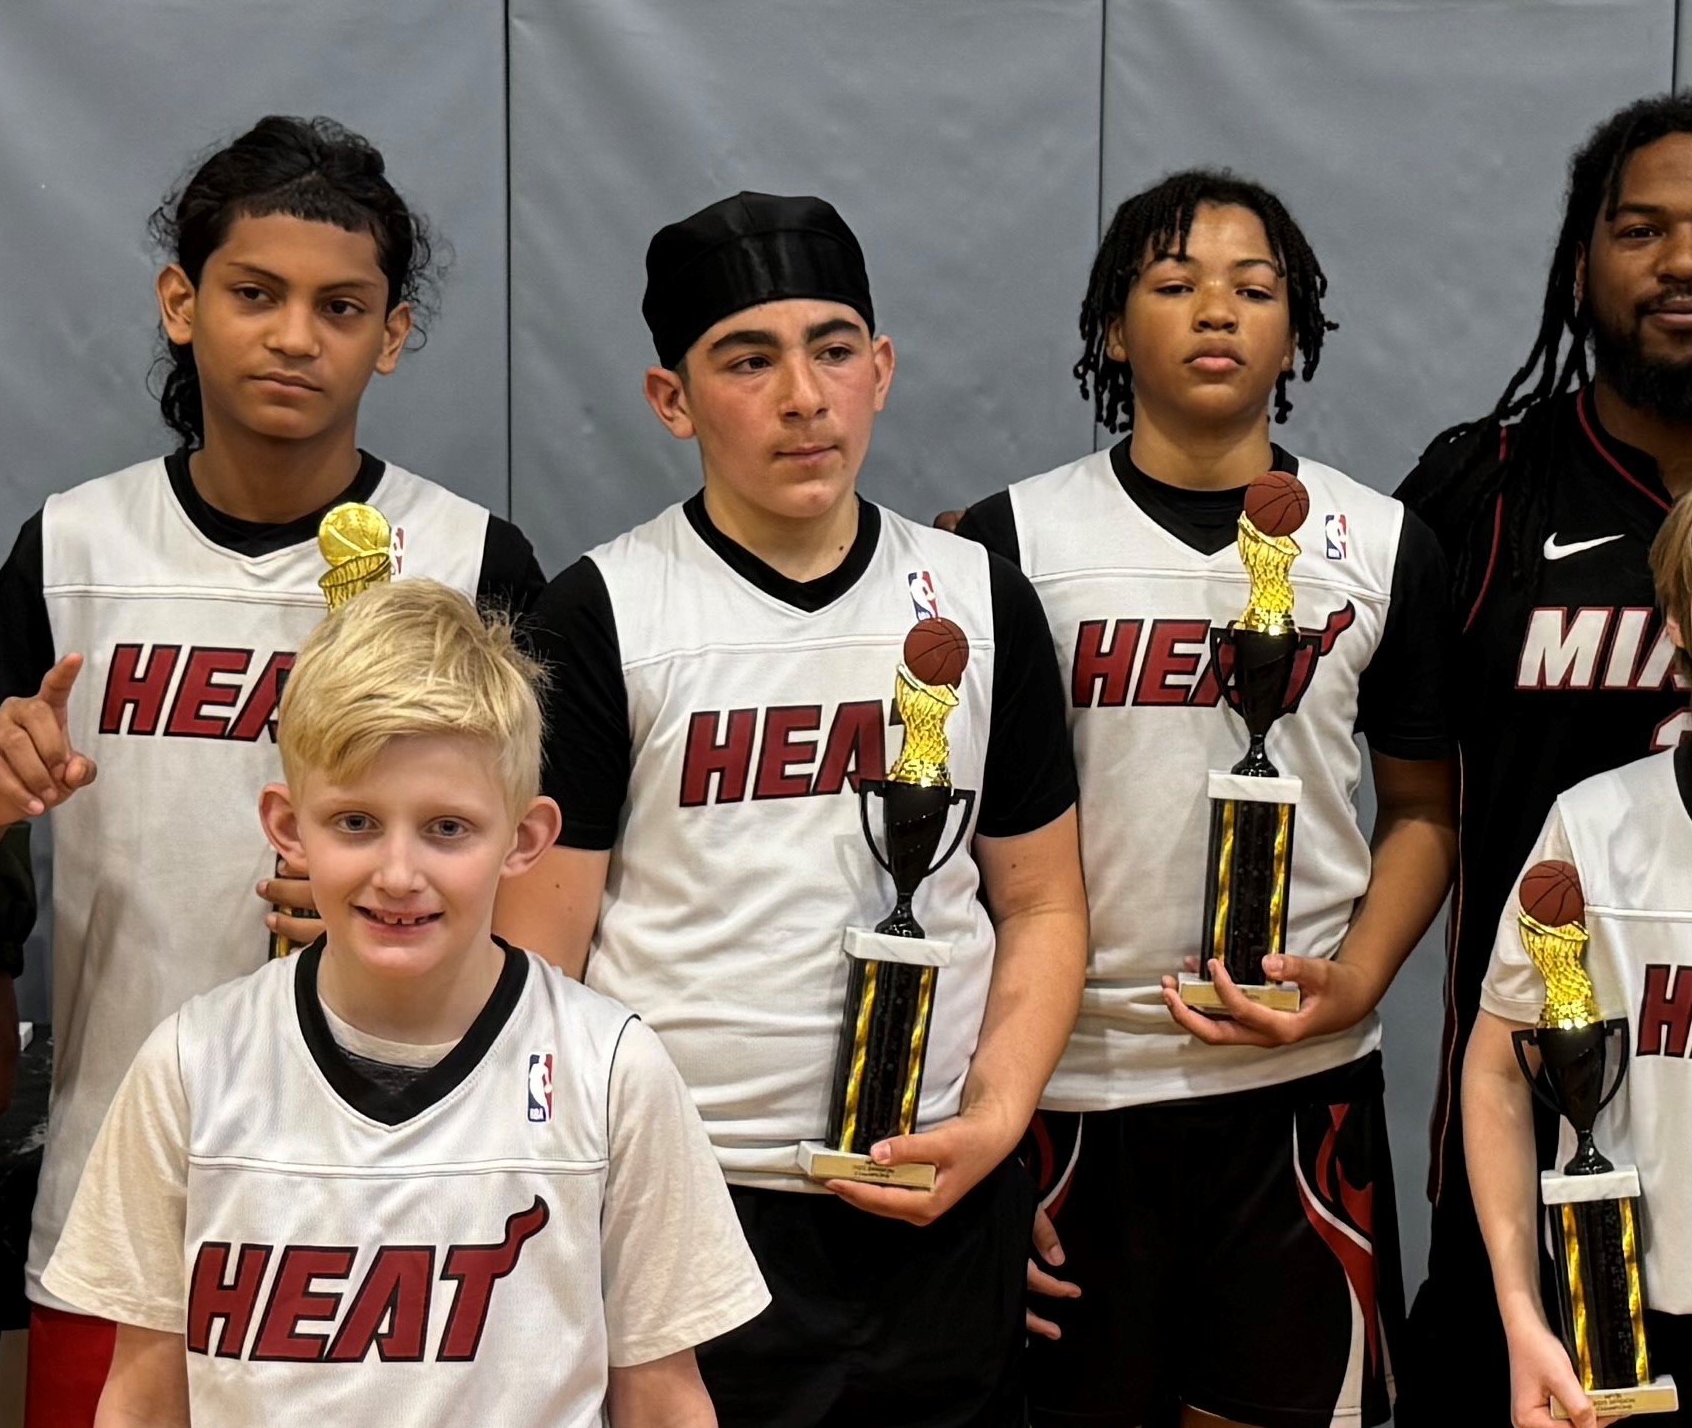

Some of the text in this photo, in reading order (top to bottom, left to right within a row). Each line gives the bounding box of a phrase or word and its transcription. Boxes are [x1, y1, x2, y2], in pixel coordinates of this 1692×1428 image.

[99, 643, 298, 744] HEA
[679, 699, 905, 808] HEA
[187, 1195, 550, 1363] HEAT
